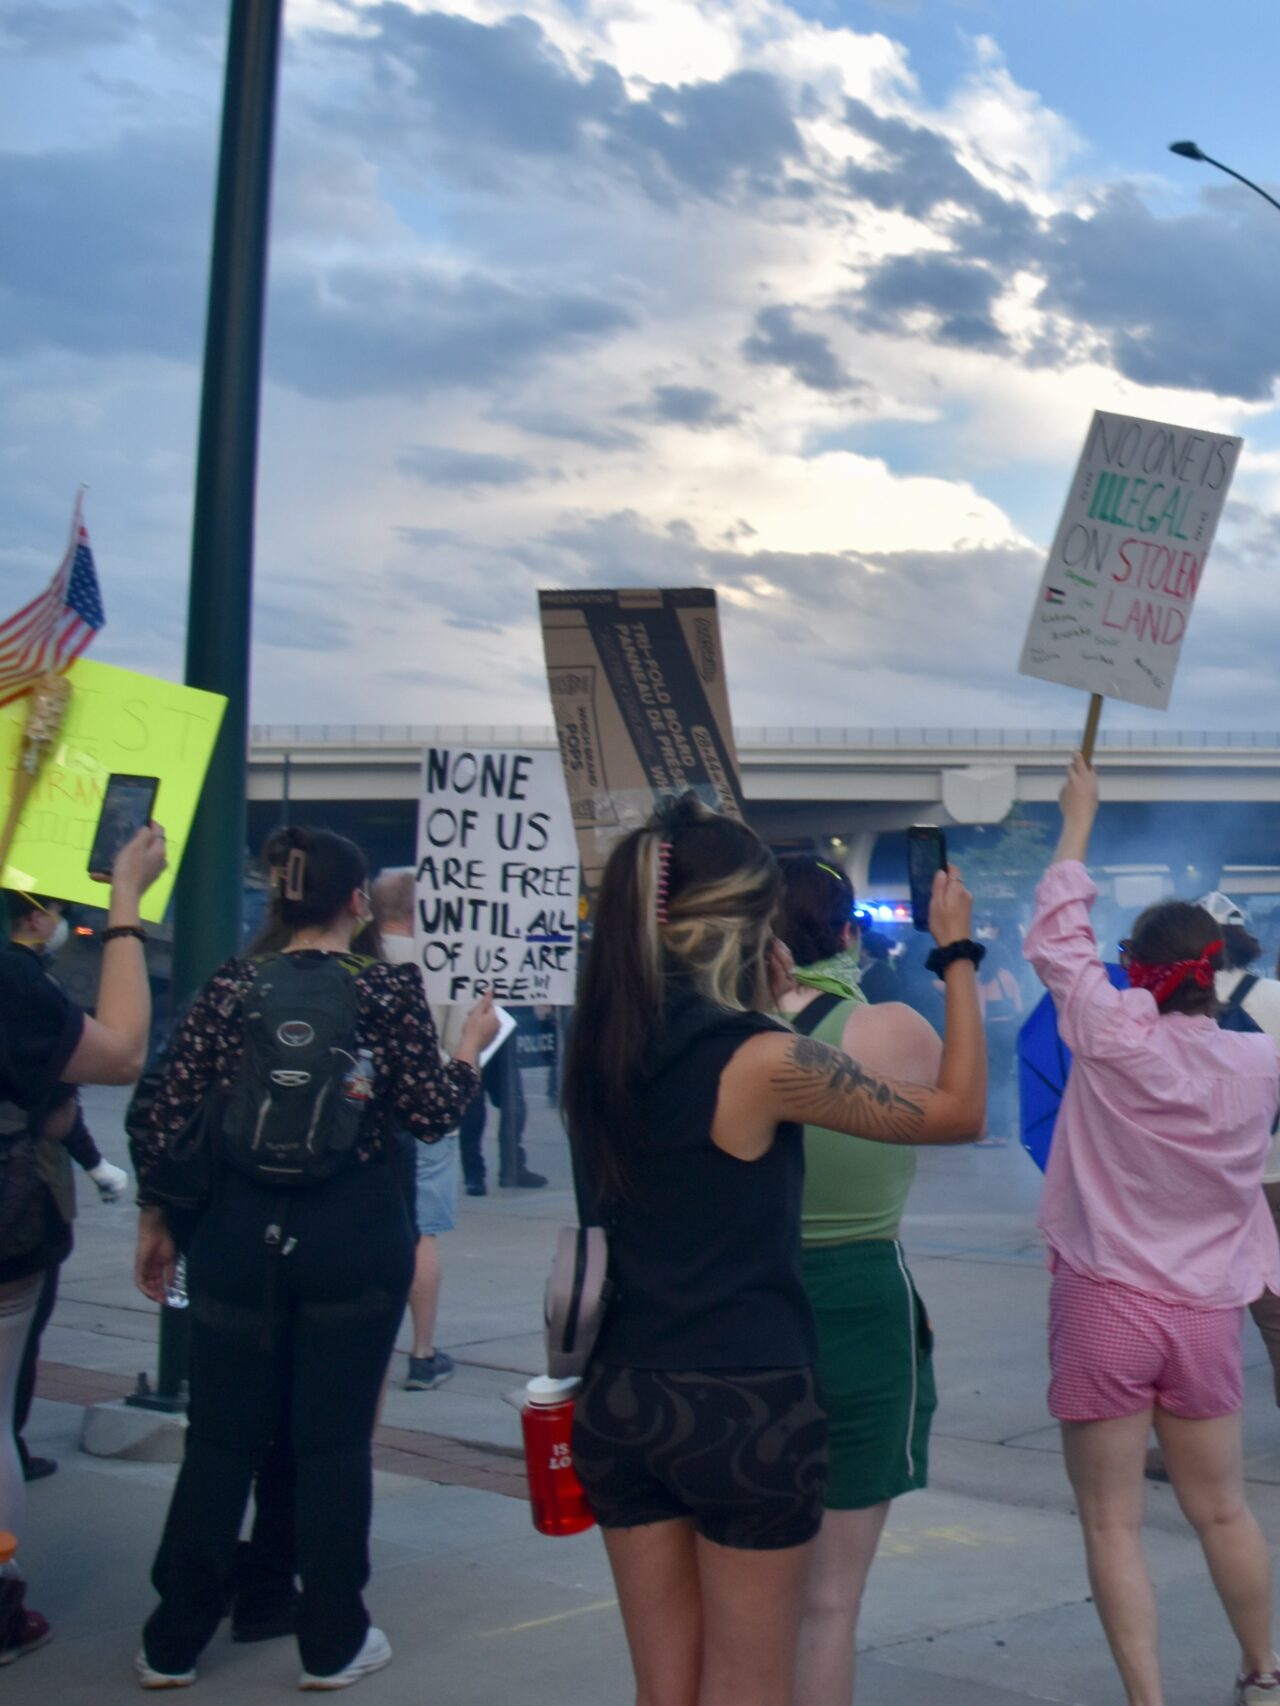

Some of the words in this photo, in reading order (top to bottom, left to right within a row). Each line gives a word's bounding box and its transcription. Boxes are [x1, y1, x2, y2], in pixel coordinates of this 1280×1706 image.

[1087, 418, 1141, 469] NO
[1143, 429, 1205, 482] ONE
[1199, 440, 1235, 490] IS
[1087, 471, 1196, 541] ILLEGAL
[1063, 524, 1111, 574] ON
[1111, 538, 1207, 600] STOLEN
[1102, 589, 1186, 646] LAND
[614, 624, 655, 705] PANNEAU
[646, 709, 667, 732] DE
[566, 723, 583, 772] POPS
[662, 708, 695, 767] BOARD
[426, 748, 533, 800] NONE
[427, 808, 478, 848] OF
[497, 812, 551, 851] US
[415, 856, 487, 890] ARE
[501, 862, 576, 898] FREE
[526, 910, 576, 936] ALL
[422, 941, 463, 972] OF
[475, 945, 509, 974] US
[519, 945, 573, 972] ARE
[516, 1033, 555, 1053] POLICE
